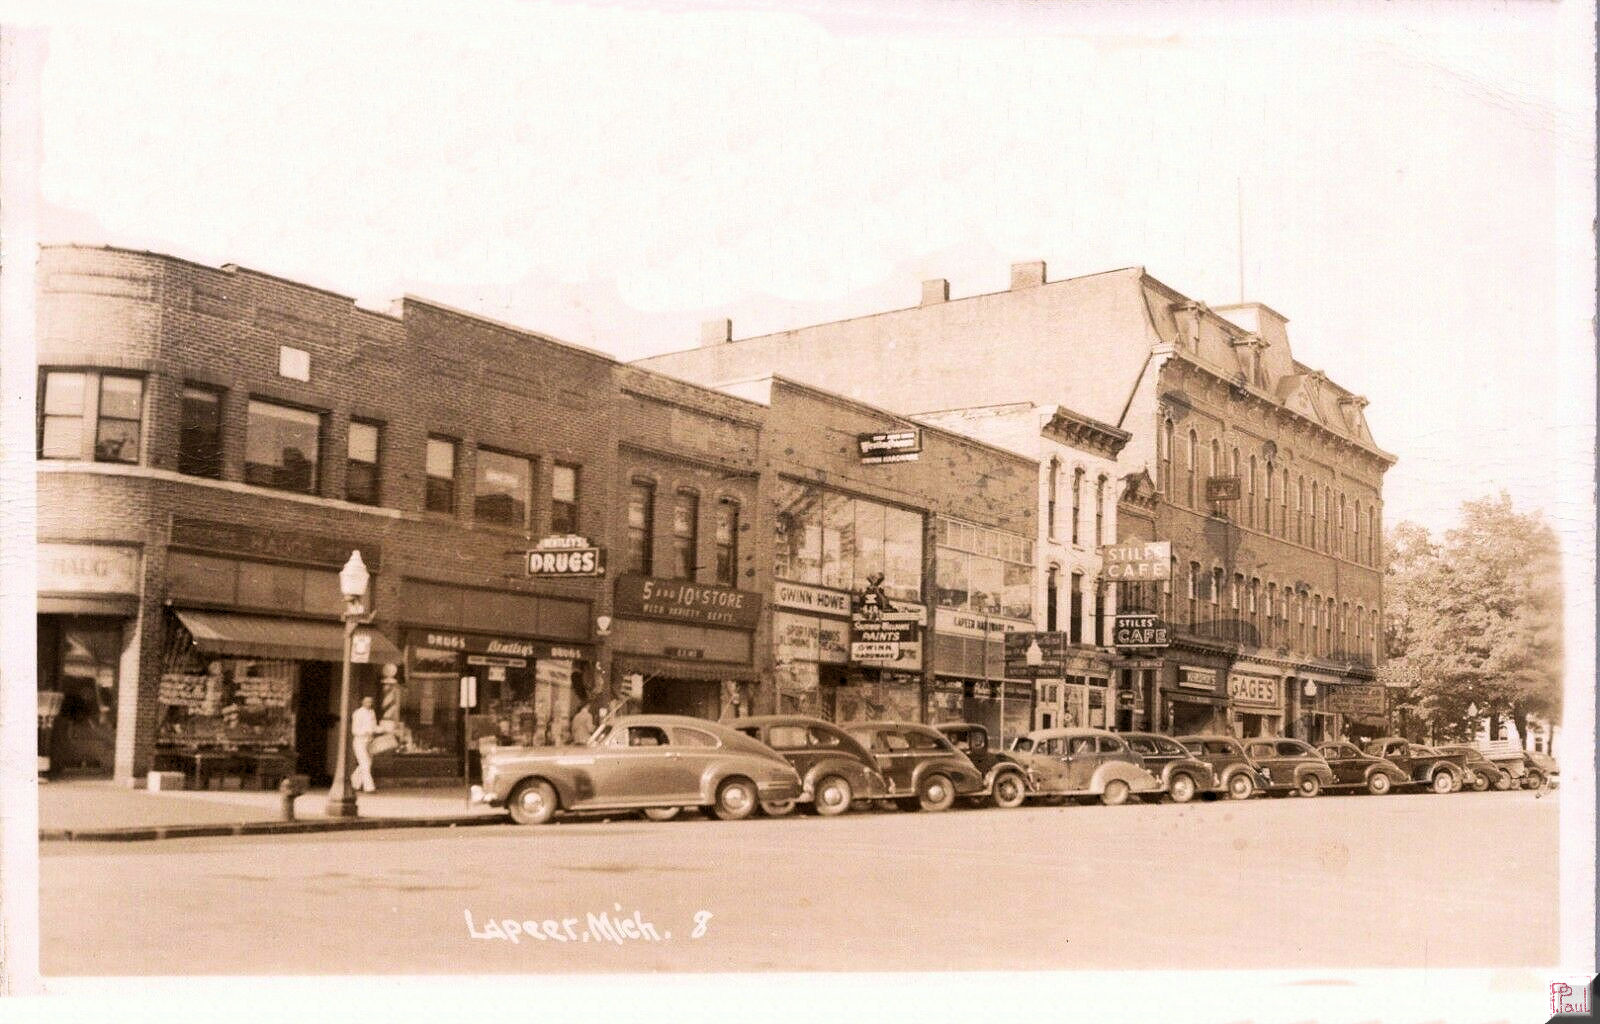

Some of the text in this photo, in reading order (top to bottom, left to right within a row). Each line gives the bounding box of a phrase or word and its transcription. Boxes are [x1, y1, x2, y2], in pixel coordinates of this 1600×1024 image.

[530, 552, 594, 573] DRUGS
[1108, 563, 1163, 578] CAFE
[702, 589, 744, 609] STORE
[780, 586, 813, 605] GWINN
[427, 633, 466, 649] DRUGS
[861, 631, 900, 642] PAINTS
[1117, 628, 1168, 644] CAFE
